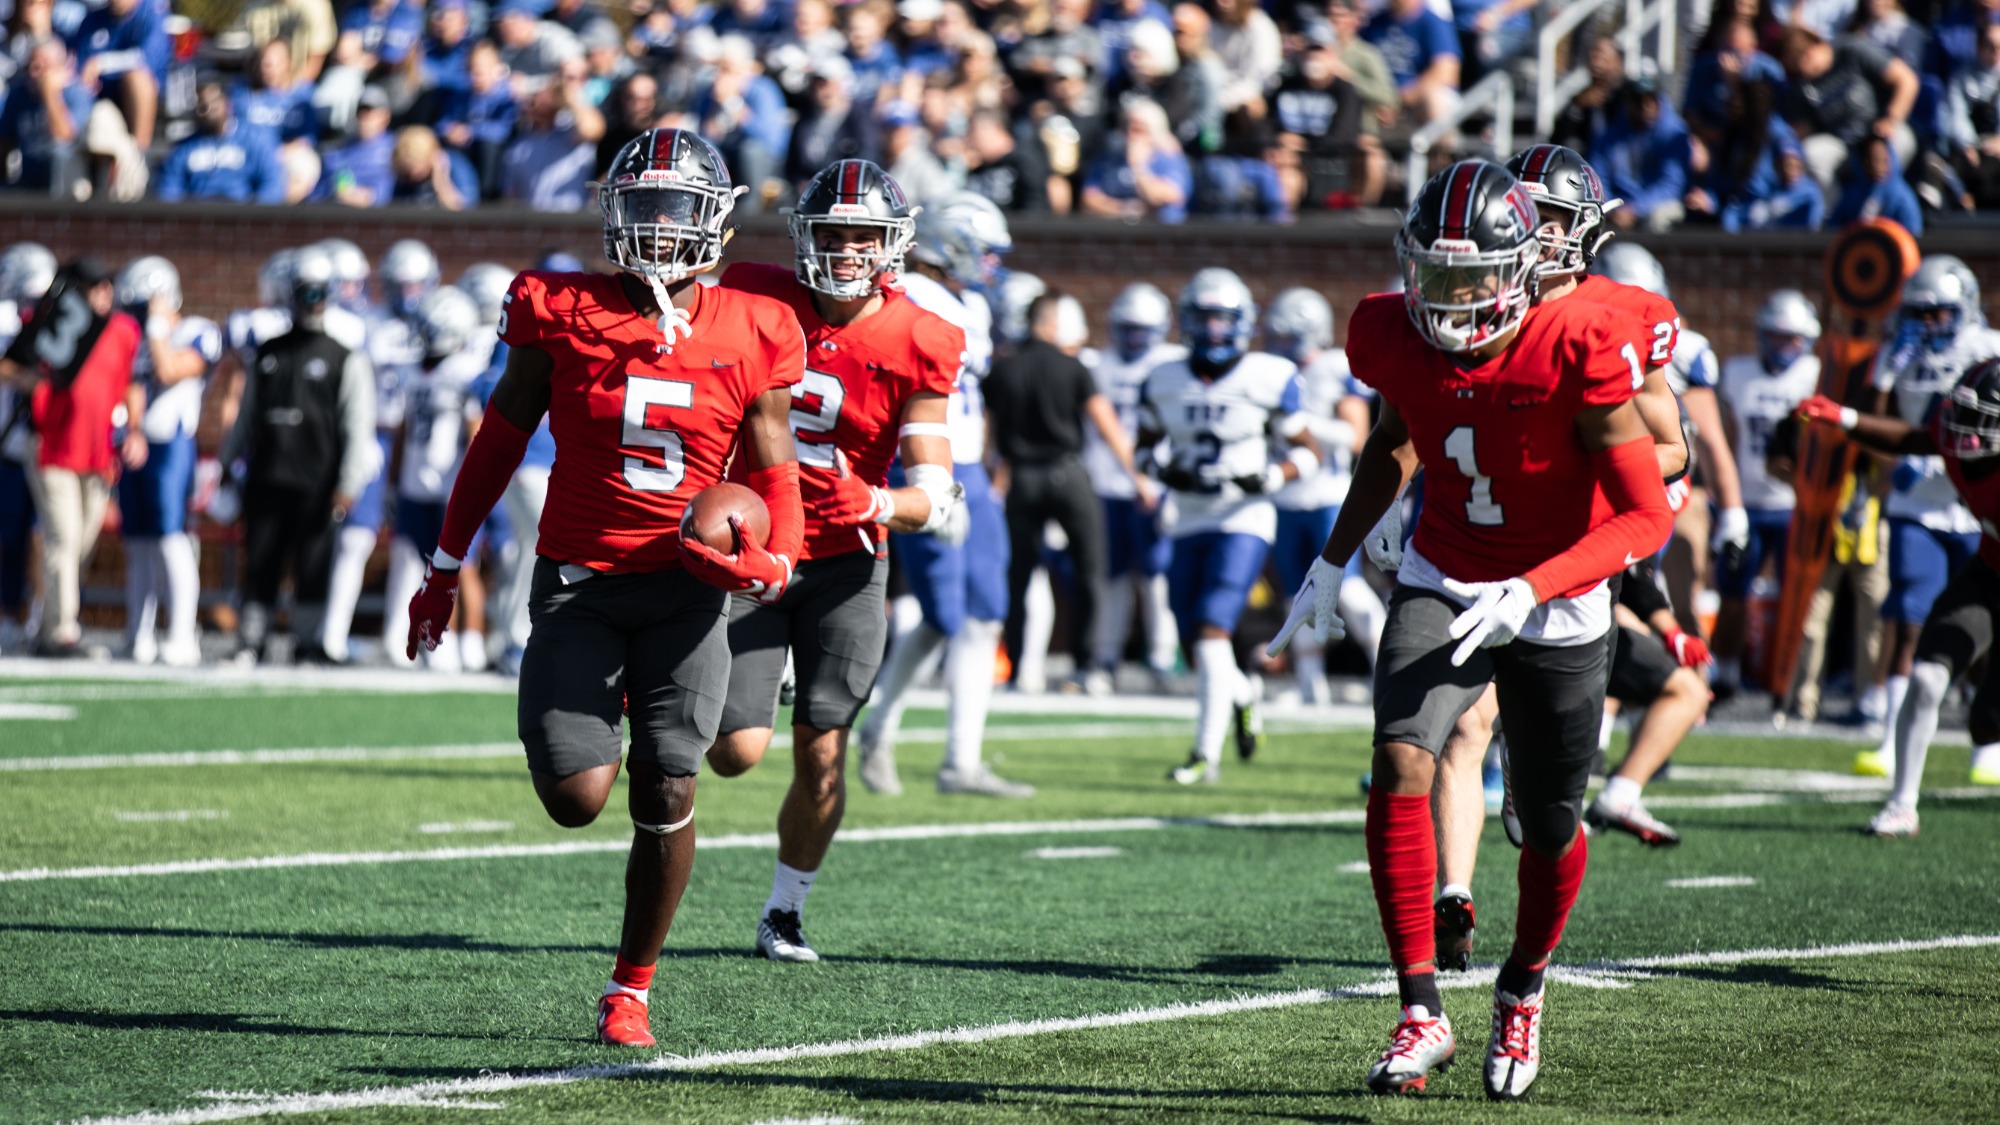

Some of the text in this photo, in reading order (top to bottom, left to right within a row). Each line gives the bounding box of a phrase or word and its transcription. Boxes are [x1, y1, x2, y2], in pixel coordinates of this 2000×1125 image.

[35, 287, 93, 370] 3
[1619, 341, 1645, 391] 1
[620, 374, 696, 493] 5
[789, 366, 847, 470] 2
[1443, 424, 1506, 527] 1
